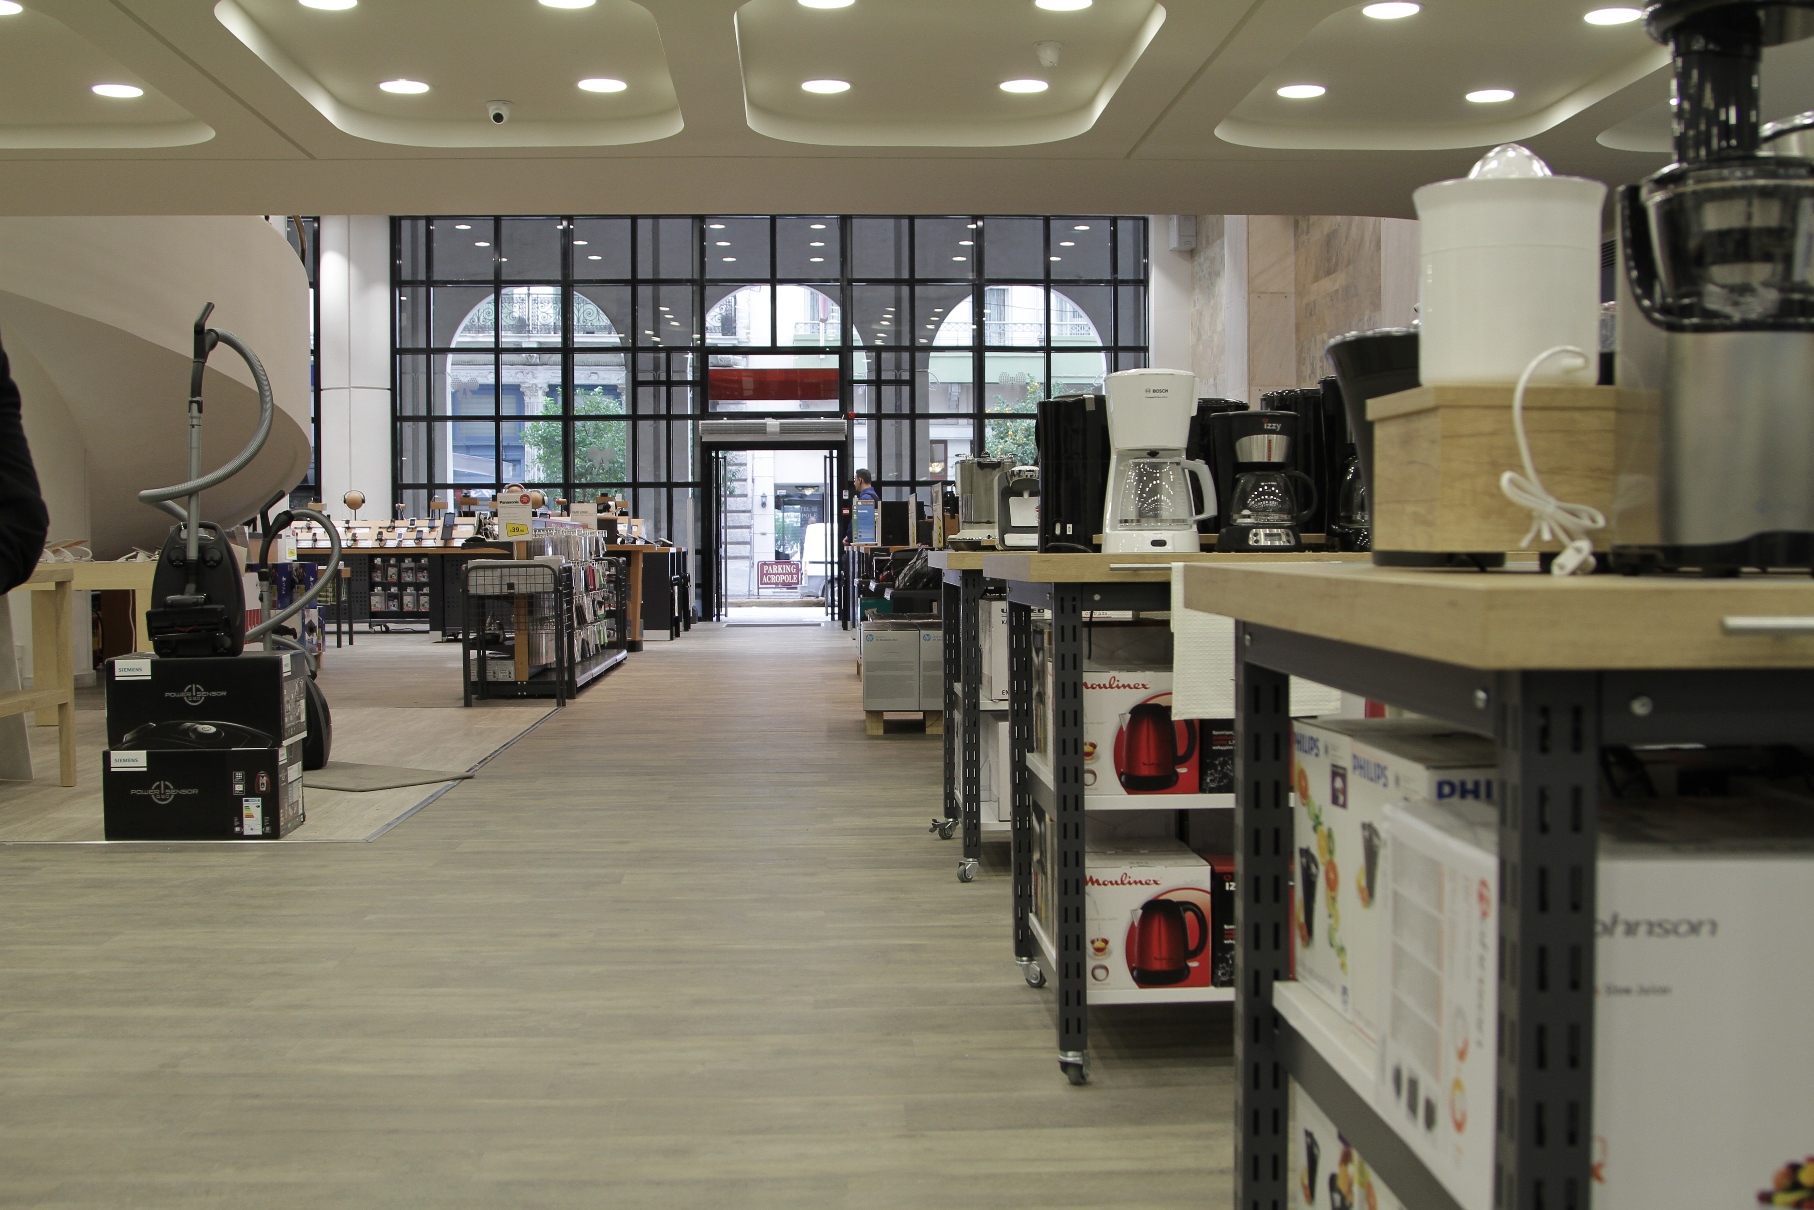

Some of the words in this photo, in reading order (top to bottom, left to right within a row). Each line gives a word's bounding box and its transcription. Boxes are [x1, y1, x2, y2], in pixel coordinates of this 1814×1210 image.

[1263, 418, 1282, 431] izzy
[763, 564, 796, 574] PARKING
[762, 574, 798, 583] ACROPOLE
[1352, 753, 1389, 787] PHILIPS
[1225, 882, 1237, 891] IZ
